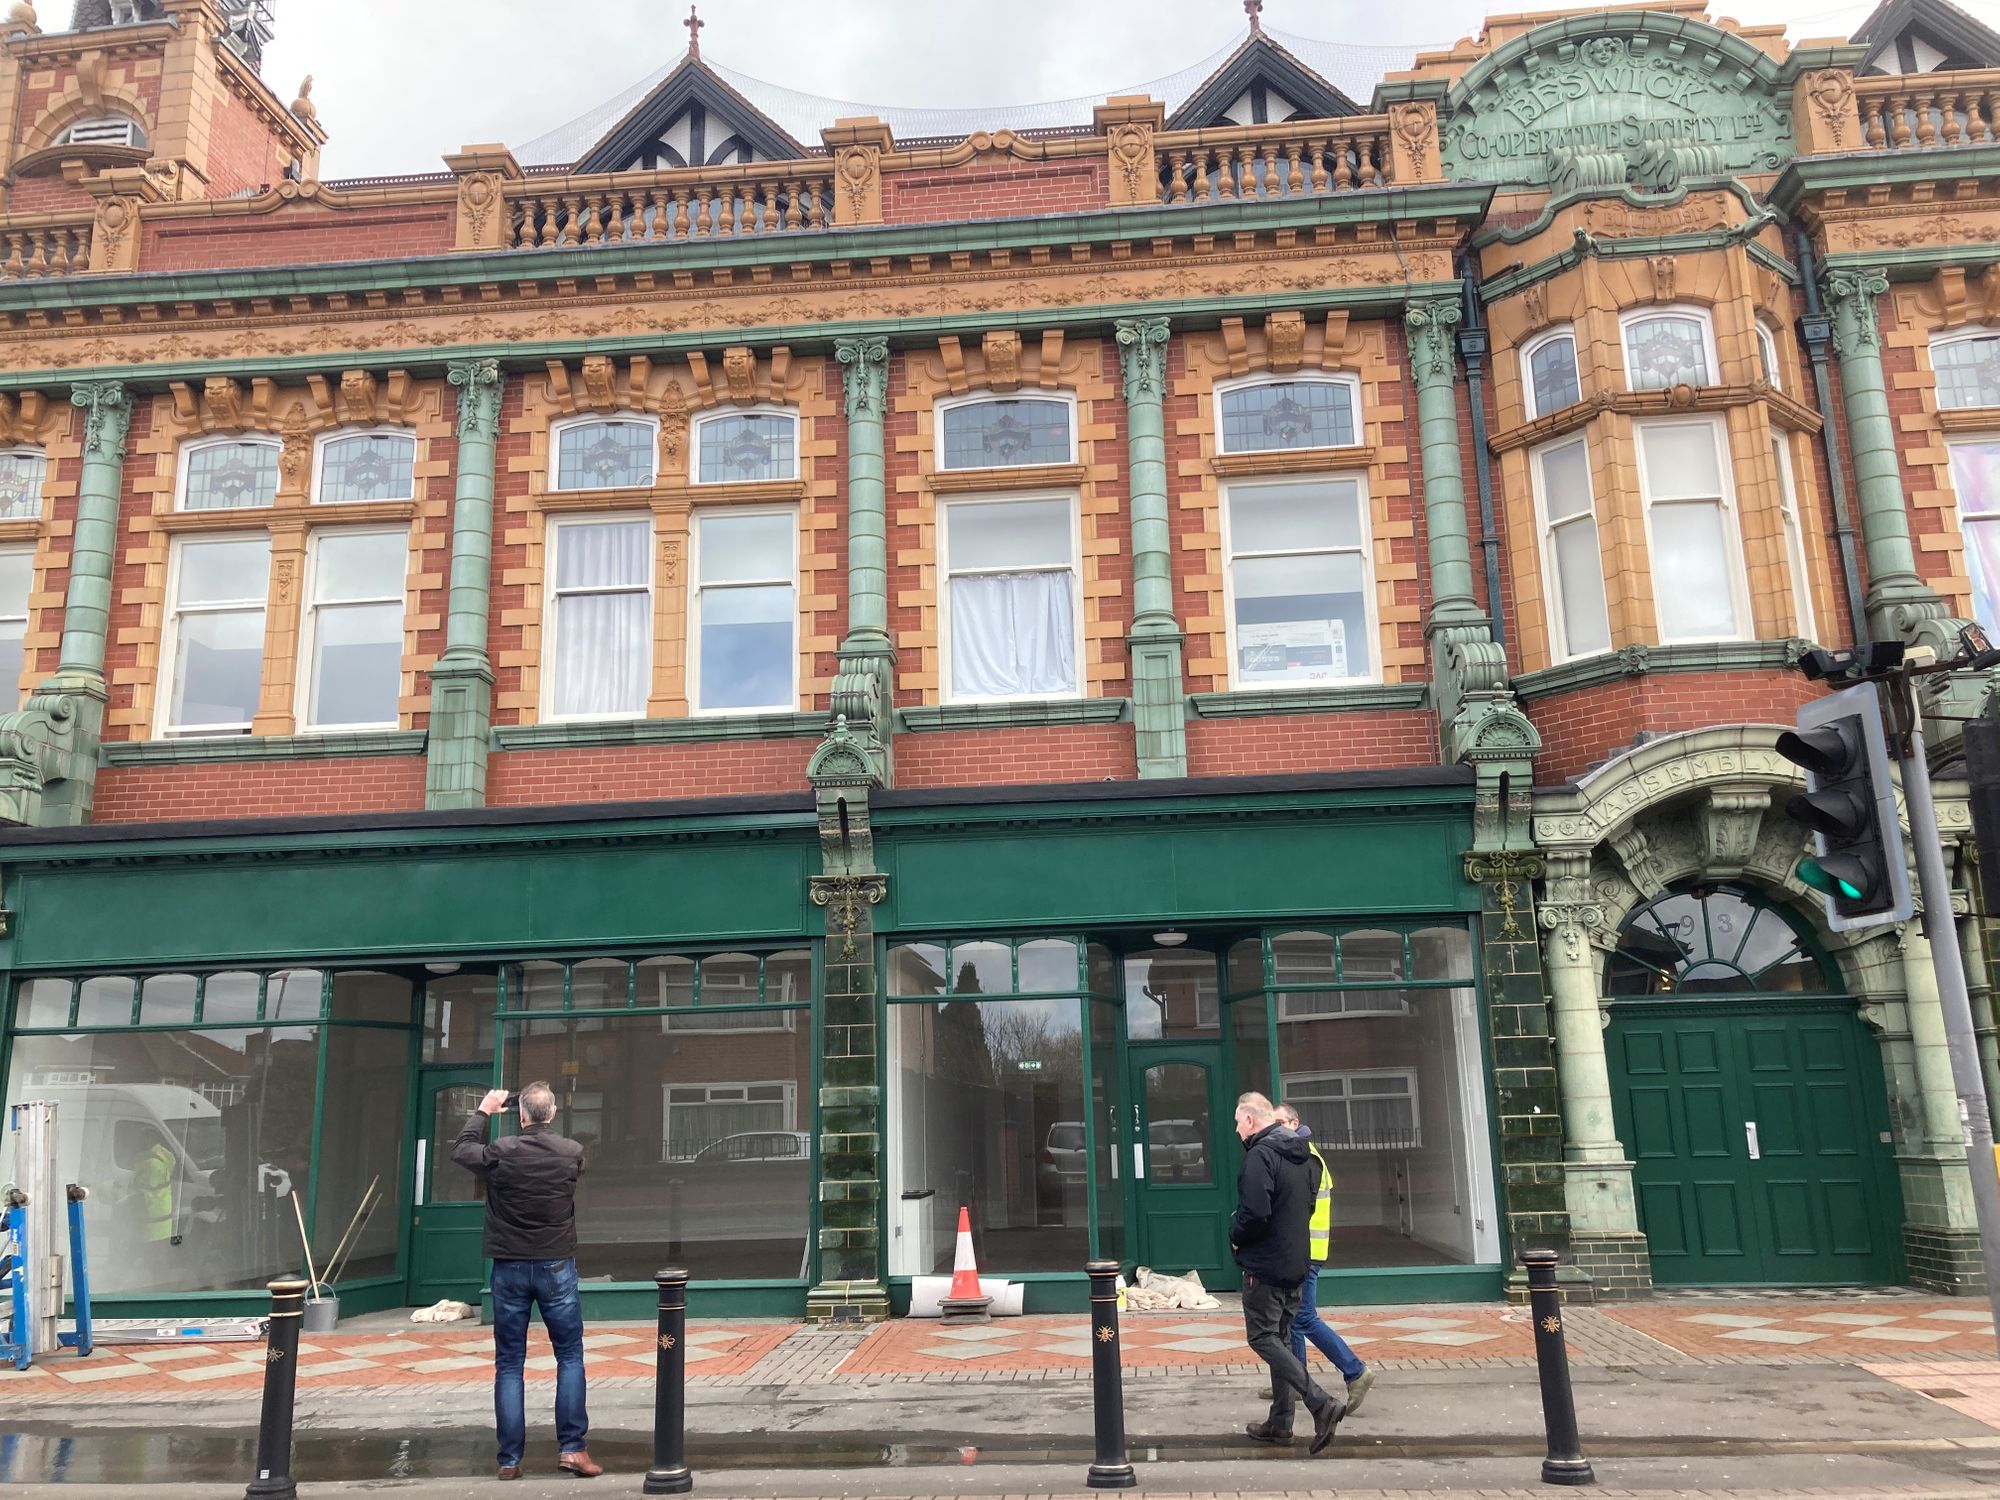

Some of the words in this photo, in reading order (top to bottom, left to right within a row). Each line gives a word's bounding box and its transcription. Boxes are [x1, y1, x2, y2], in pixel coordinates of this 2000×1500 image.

[1505, 68, 1708, 128] BESWICK
[1622, 113, 1724, 147] SOCIETY
[1602, 752, 1782, 820] ASSEMBLY
